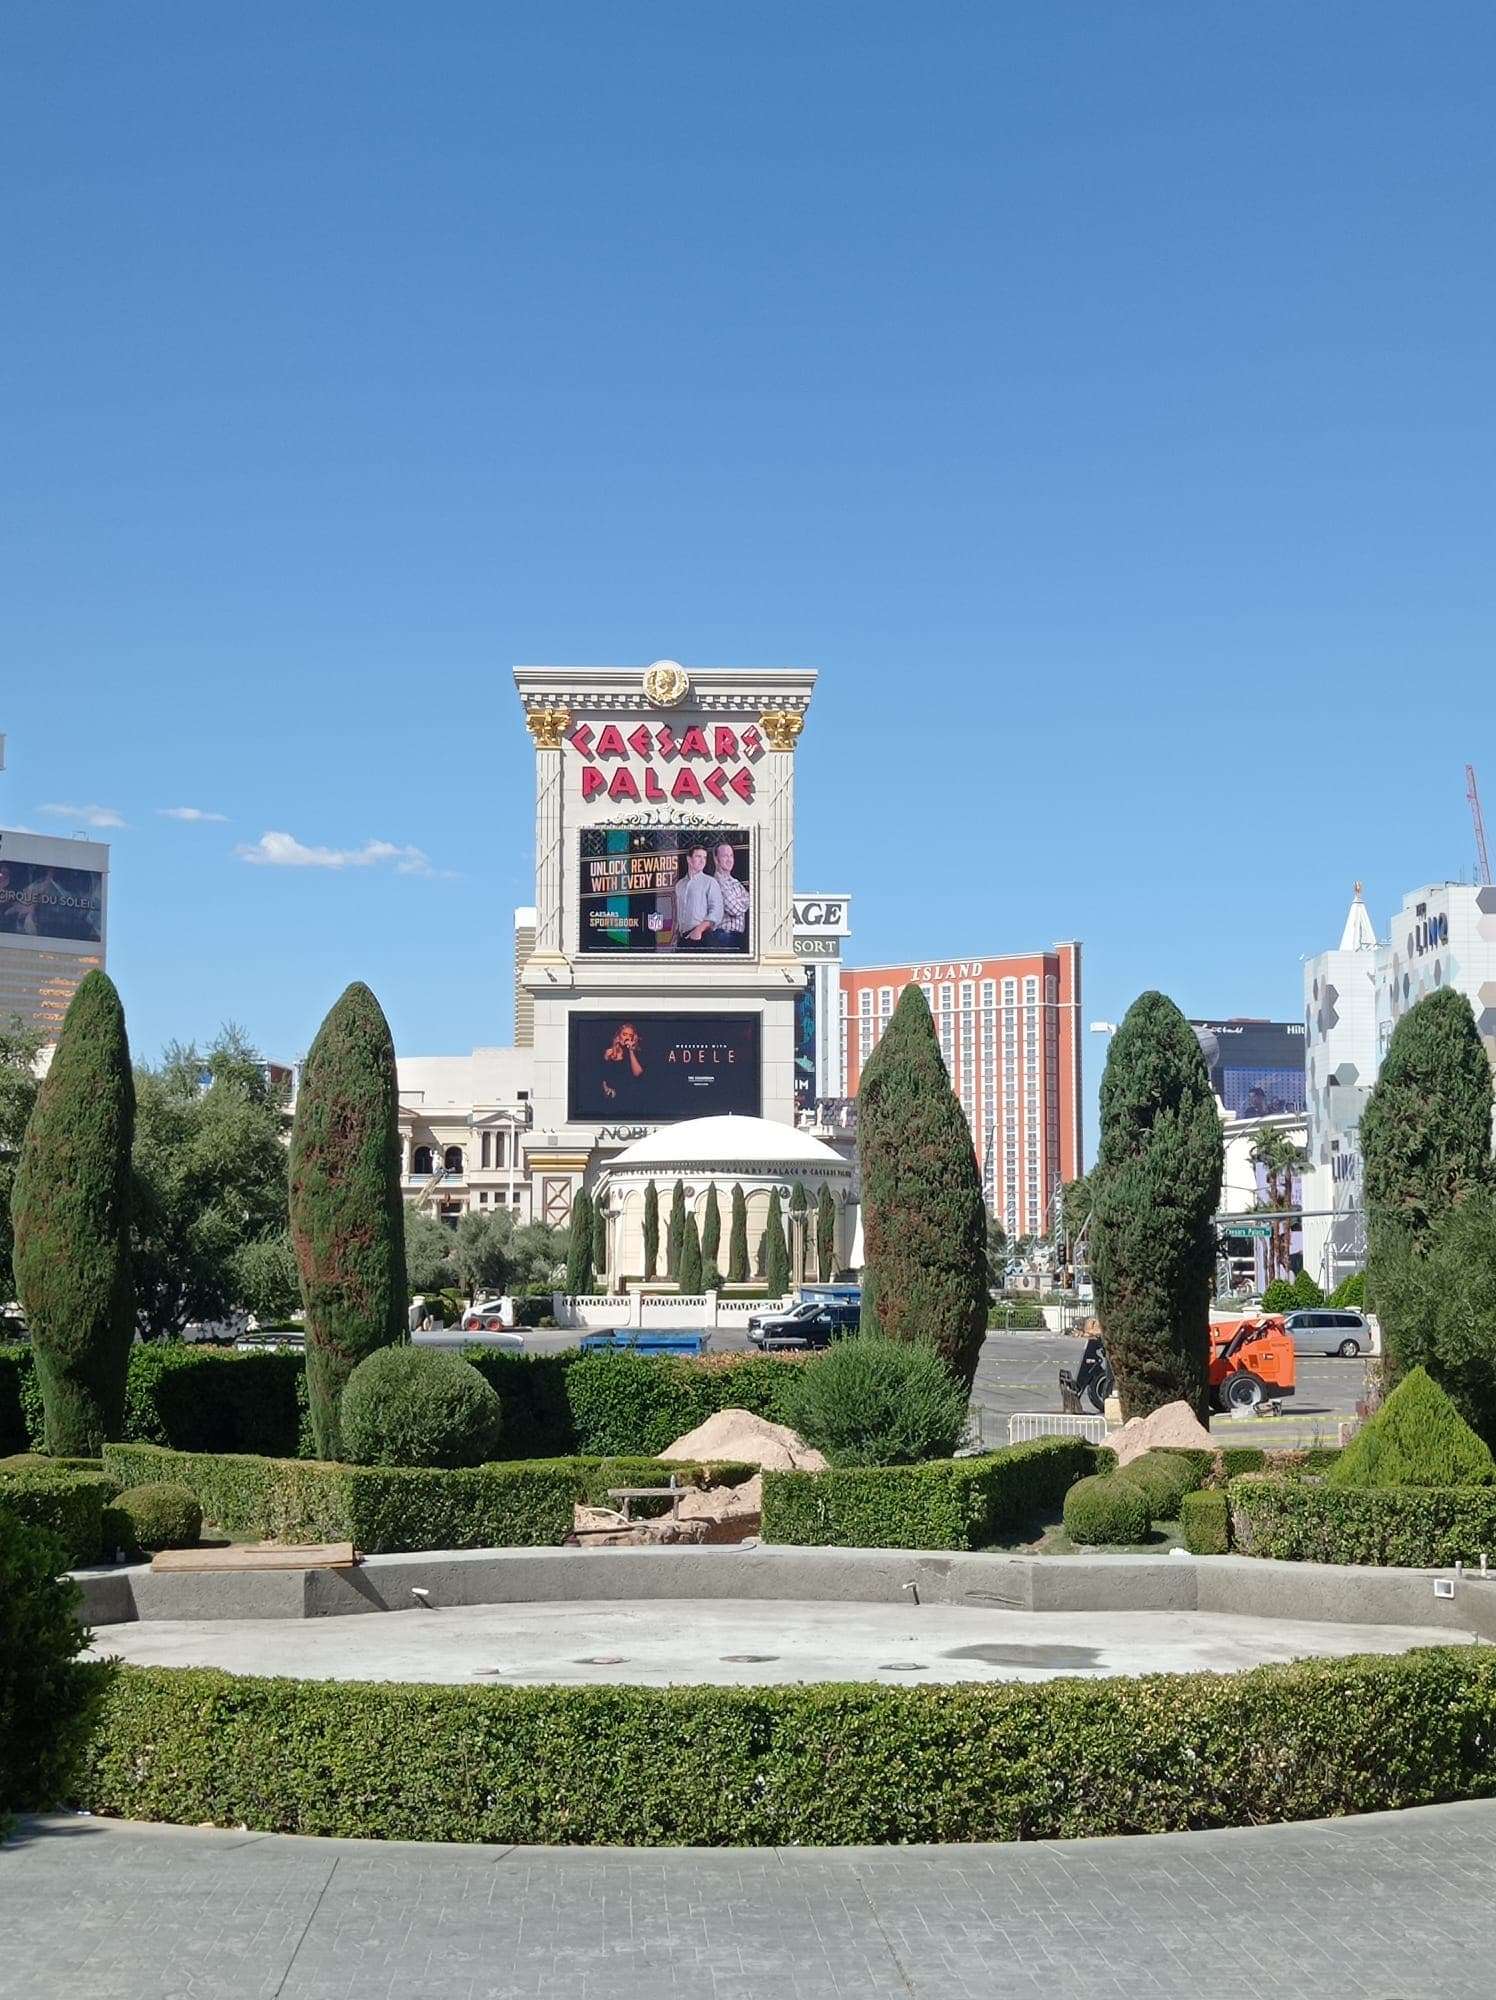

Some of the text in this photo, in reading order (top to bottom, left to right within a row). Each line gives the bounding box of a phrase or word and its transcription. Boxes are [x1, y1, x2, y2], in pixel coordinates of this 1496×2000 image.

[570, 723, 766, 765] CAESARS
[582, 766, 756, 805] PALACE
[590, 856, 679, 877] UNLOCK REWARDS
[591, 871, 674, 892] WITH EVERY BET
[0, 889, 96, 909] CIRQUE DU SOLEIL
[589, 918, 639, 927] SPORTSBOOK
[1416, 913, 1448, 956] LINQ
[794, 940, 836, 953] SORT
[910, 962, 983, 982] ISLAND
[668, 1050, 735, 1063] ADELE
[767, 1168, 799, 1176] PALACE
